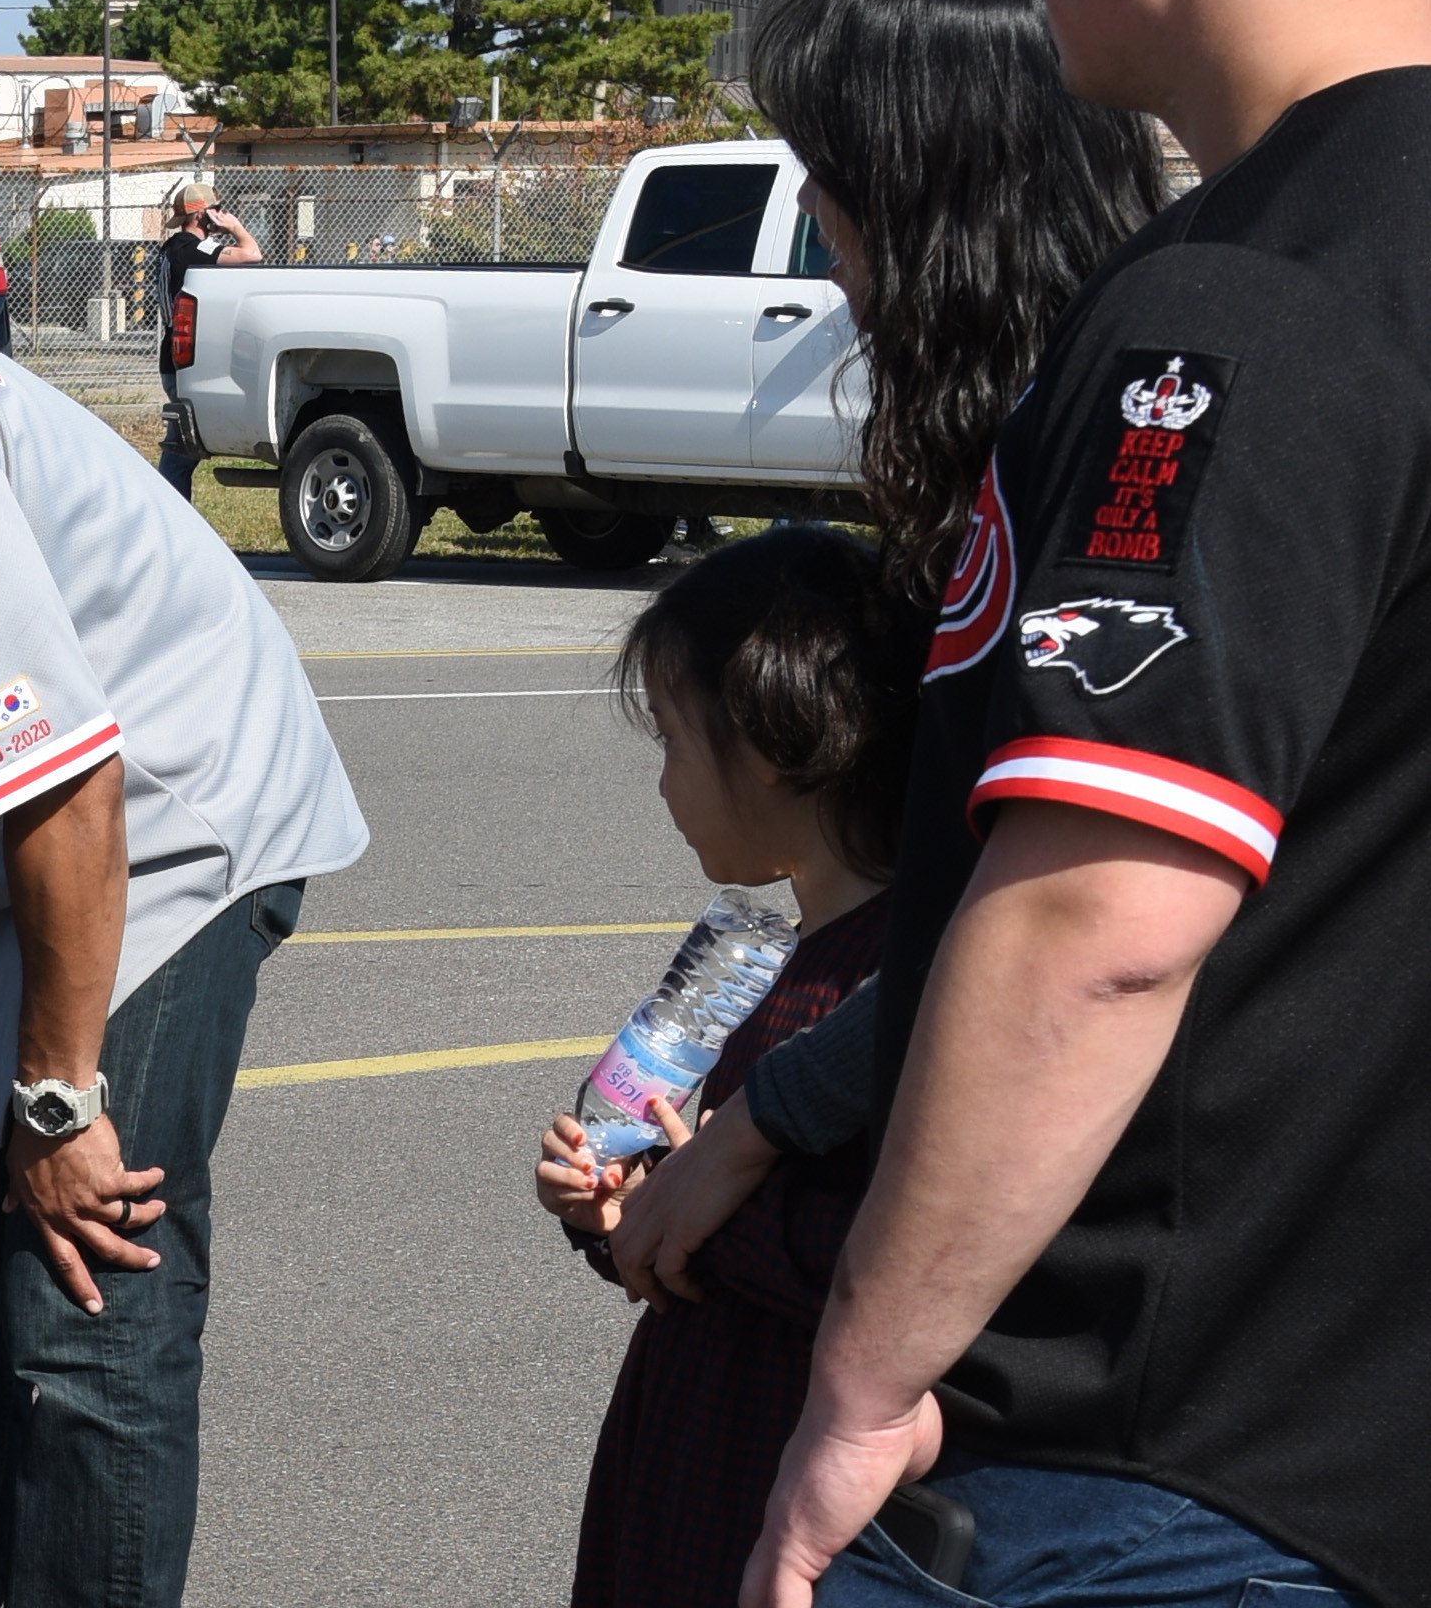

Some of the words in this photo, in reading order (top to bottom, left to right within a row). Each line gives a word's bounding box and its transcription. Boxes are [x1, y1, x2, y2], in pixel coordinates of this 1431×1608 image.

[1119, 428, 1184, 458] KEEP
[1109, 458, 1179, 485] CALM
[1096, 505, 1140, 528] ONLY
[1142, 510, 1157, 530] A
[1086, 530, 1161, 561] BOMB
[607, 1072, 643, 1103] ICIS
